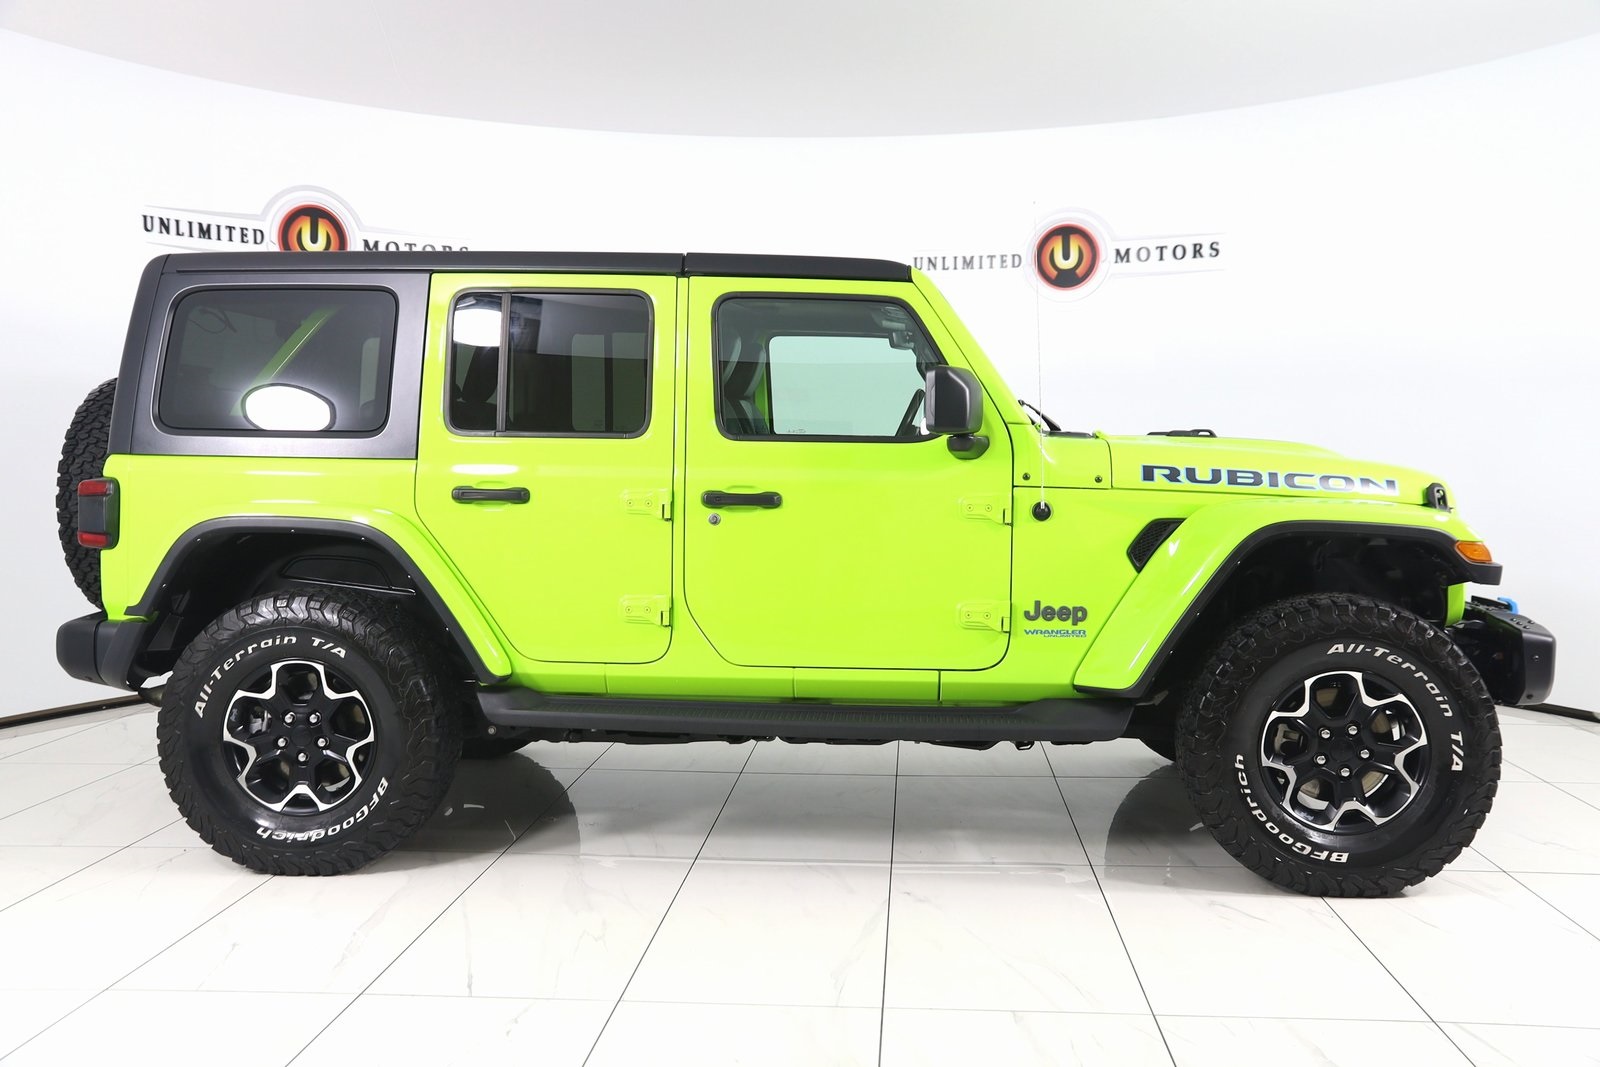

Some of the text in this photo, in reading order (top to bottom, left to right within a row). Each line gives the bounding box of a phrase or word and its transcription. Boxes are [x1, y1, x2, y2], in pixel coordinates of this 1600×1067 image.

[142, 214, 265, 245] UNLIMITED
[913, 253, 1022, 271] UNLIMITED
[1114, 241, 1220, 264] MOTORS
[1142, 464, 1398, 494] RUBICON
[1023, 600, 1088, 626] Jeep
[194, 634, 346, 718] All-Terrain T/A
[1326, 643, 1465, 772] All-Terrain T/A
[256, 777, 388, 842] BFGoodrich
[1234, 754, 1349, 863] BFGoodrich
